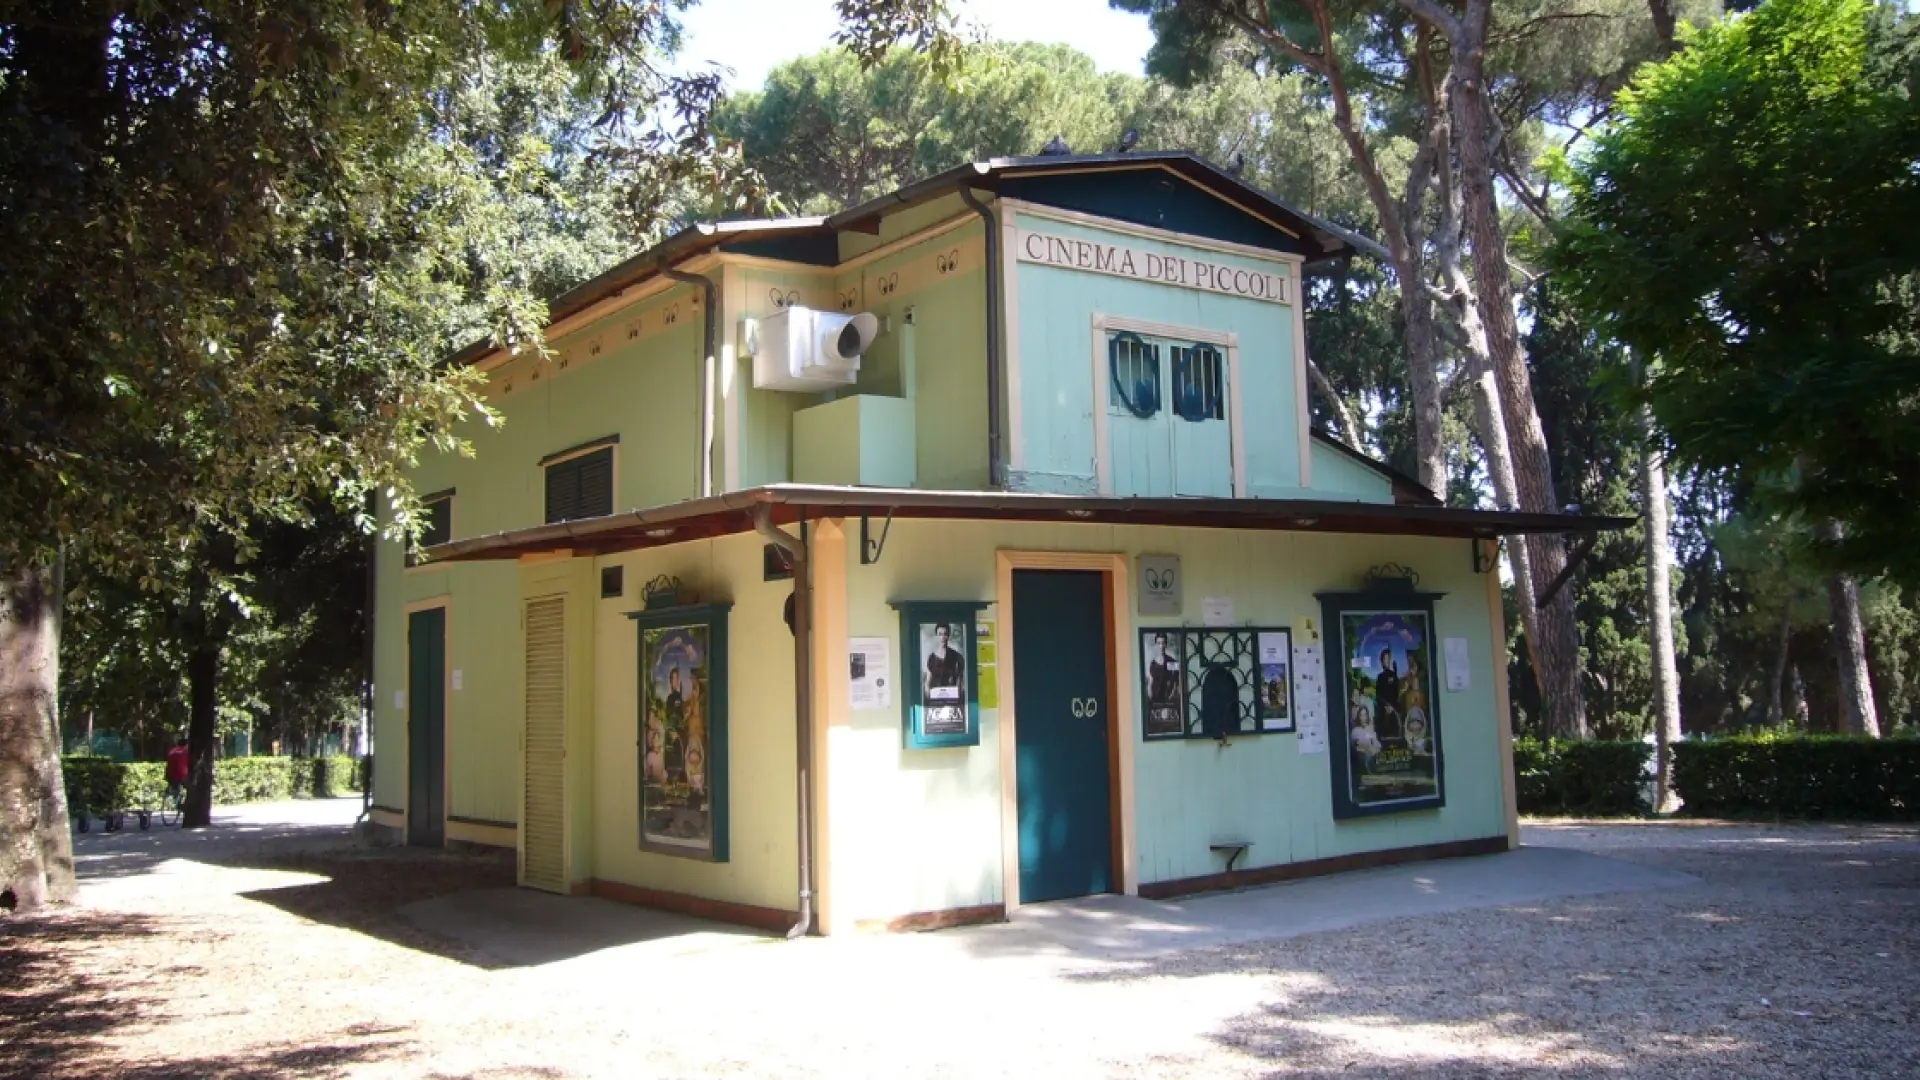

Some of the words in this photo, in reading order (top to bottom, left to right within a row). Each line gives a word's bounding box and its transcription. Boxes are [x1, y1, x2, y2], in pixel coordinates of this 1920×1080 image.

[1025, 232, 1136, 275] CINEMA
[1145, 252, 1187, 284] DEI
[1194, 261, 1286, 301] PICCOLI
